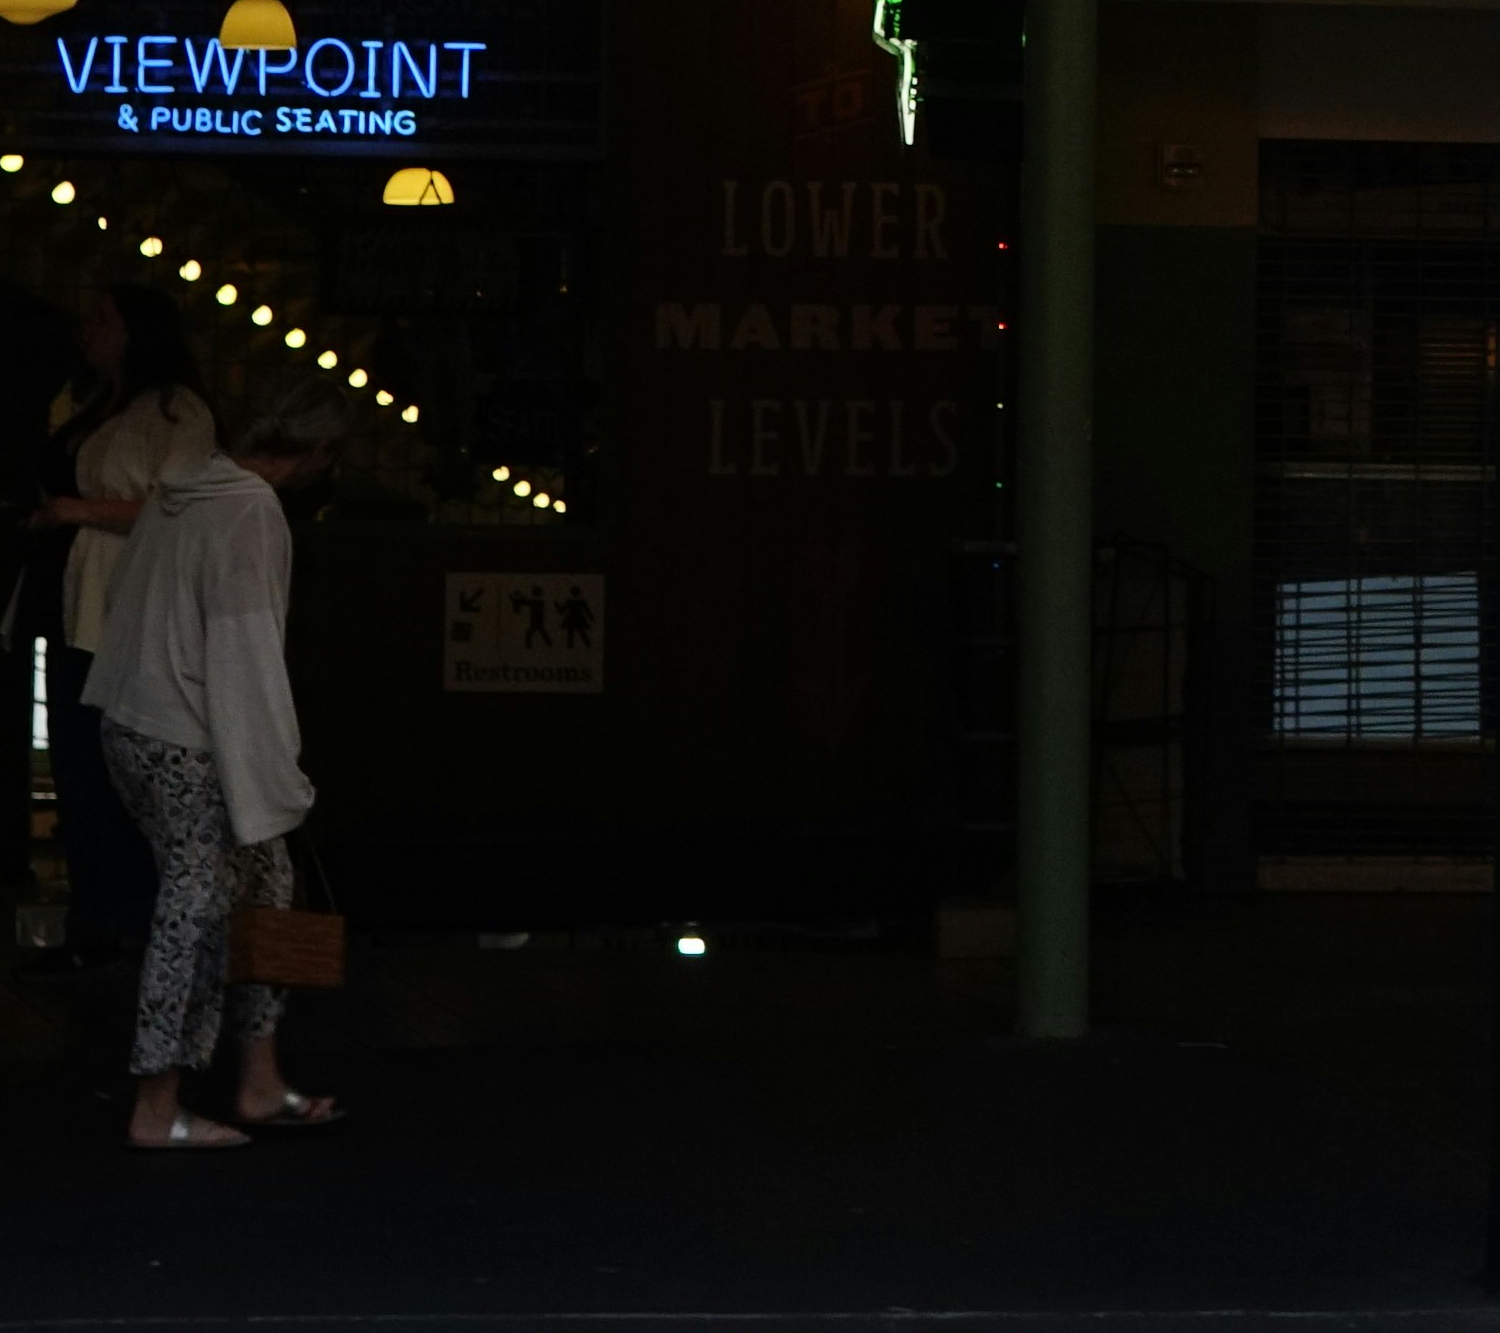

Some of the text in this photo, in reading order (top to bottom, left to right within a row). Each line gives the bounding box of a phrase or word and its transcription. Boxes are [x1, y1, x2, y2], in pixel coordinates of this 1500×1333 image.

[55, 35, 488, 100] VIEWPOINT
[117, 104, 418, 136] & PUBLIC SEATING
[719, 179, 950, 260] LOWER
[707, 397, 960, 478] LEVELS
[453, 661, 593, 683] Restrooms
